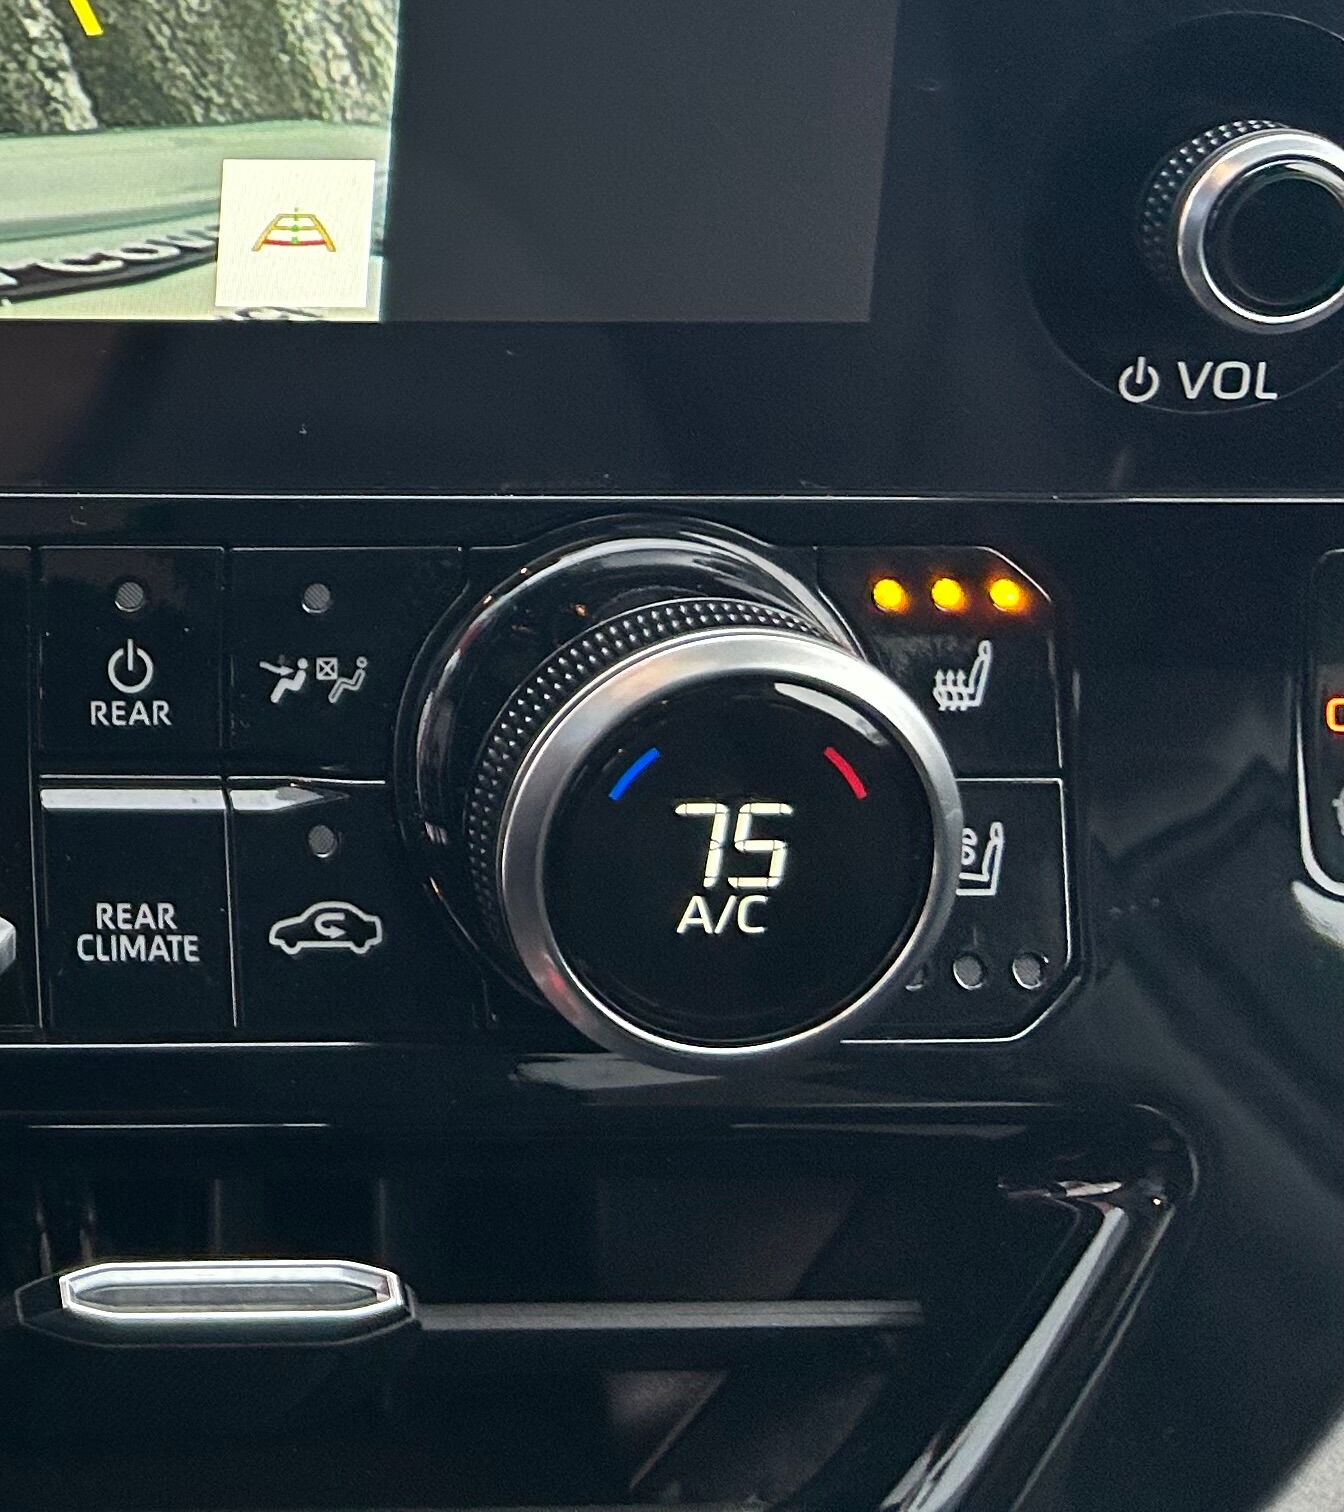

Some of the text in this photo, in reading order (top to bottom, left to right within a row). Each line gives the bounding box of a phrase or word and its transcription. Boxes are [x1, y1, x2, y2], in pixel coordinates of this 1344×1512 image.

[1176, 360, 1279, 401] VOL
[89, 699, 173, 727] REAR
[673, 801, 794, 890] 75
[95, 901, 178, 931] REAR
[675, 894, 770, 934] A/C
[75, 932, 200, 964] CLIMATE
